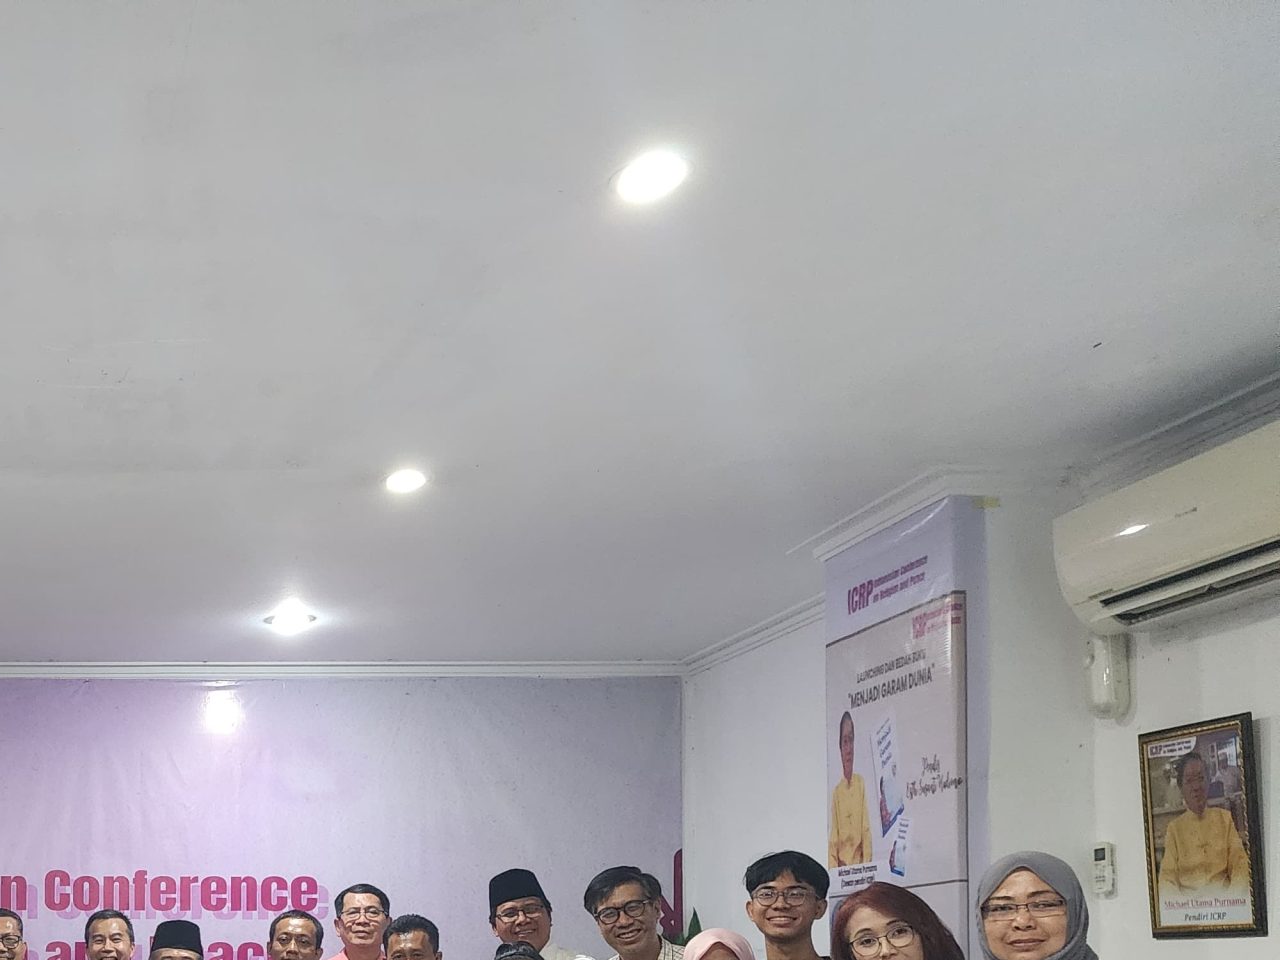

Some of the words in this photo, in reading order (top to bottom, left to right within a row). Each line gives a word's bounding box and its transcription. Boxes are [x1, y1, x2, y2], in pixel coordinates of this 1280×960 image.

[847, 579, 873, 615] ICRP
[885, 659, 895, 674] DAN
[881, 673, 908, 698] GARAM
[44, 868, 319, 912] Conference
[1164, 899, 1190, 909] Michael
[1190, 899, 1213, 908] Utama
[1214, 897, 1246, 907] Purnama
[1184, 911, 1209, 921] Pendiri
[1210, 911, 1227, 920] ICRP
